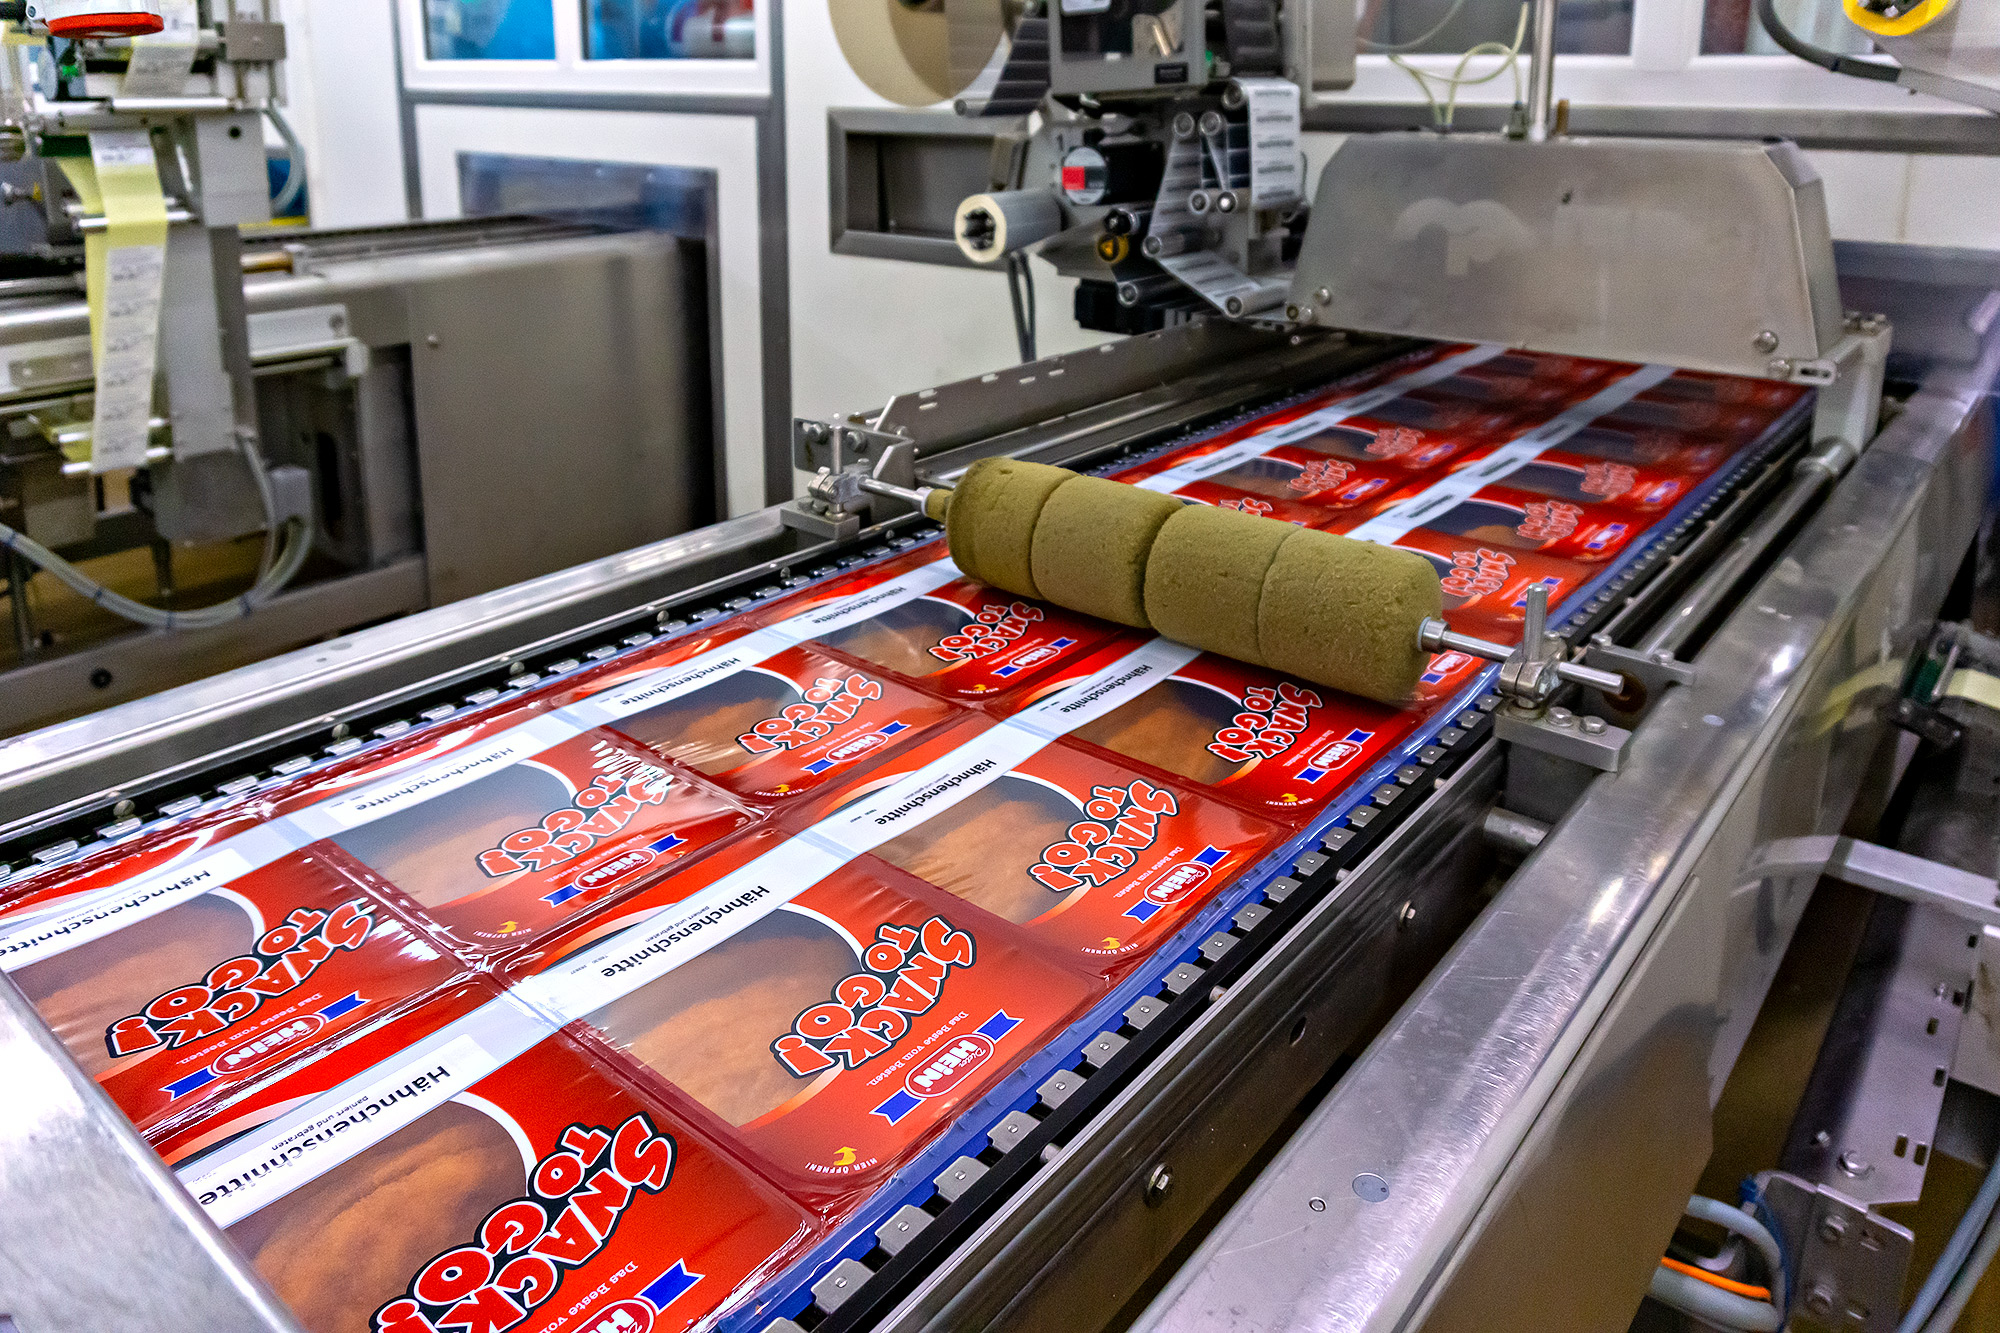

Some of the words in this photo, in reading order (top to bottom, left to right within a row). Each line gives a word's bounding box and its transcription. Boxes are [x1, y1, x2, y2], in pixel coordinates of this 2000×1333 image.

[959, 601, 1044, 659] SNACK
[976, 605, 1008, 624] TO
[929, 624, 992, 661] GO!
[620, 657, 741, 705] Hähnchenschnitte
[804, 678, 844, 703] TO
[1060, 664, 1152, 713] Hähnchenschnitte
[1244, 687, 1276, 712] TO
[738, 703, 818, 753] GO!
[772, 674, 882, 749] SNACK
[1242, 682, 1323, 758] SNACK
[1207, 712, 1269, 762] GO!
[575, 776, 627, 808] TO
[874, 759, 997, 825] Hähnchenschnitte
[1086, 786, 1128, 821] TO
[479, 808, 586, 876] GO!
[1030, 821, 1111, 891] GO!
[1071, 779, 1177, 886] SNACK
[257, 909, 328, 956] TO
[600, 886, 770, 977] Hähnchenschnitte
[865, 925, 919, 973] TO
[157, 898, 373, 1048] SNACK
[821, 917, 974, 1067] SNACK
[111, 957, 263, 1055] GO!
[260, 1004, 297, 1025] Beste
[296, 992, 323, 1005] Das
[949, 1011, 969, 1028] Das
[234, 1022, 259, 1035] vom
[774, 973, 887, 1076] GO!
[923, 1025, 950, 1047] Beste
[903, 1044, 924, 1061] vom
[314, 1114, 336, 1129] und
[336, 1095, 368, 1117] paniert
[199, 1066, 450, 1205] Hähnchenschnitte
[272, 1125, 315, 1151] gebraten
[534, 1126, 612, 1200] TO
[805, 1161, 849, 1174] ÖFFNEN!
[853, 1157, 878, 1171] HIER
[435, 1115, 673, 1333] SNACK
[609, 1261, 638, 1284] Das
[568, 1283, 611, 1315] Beste
